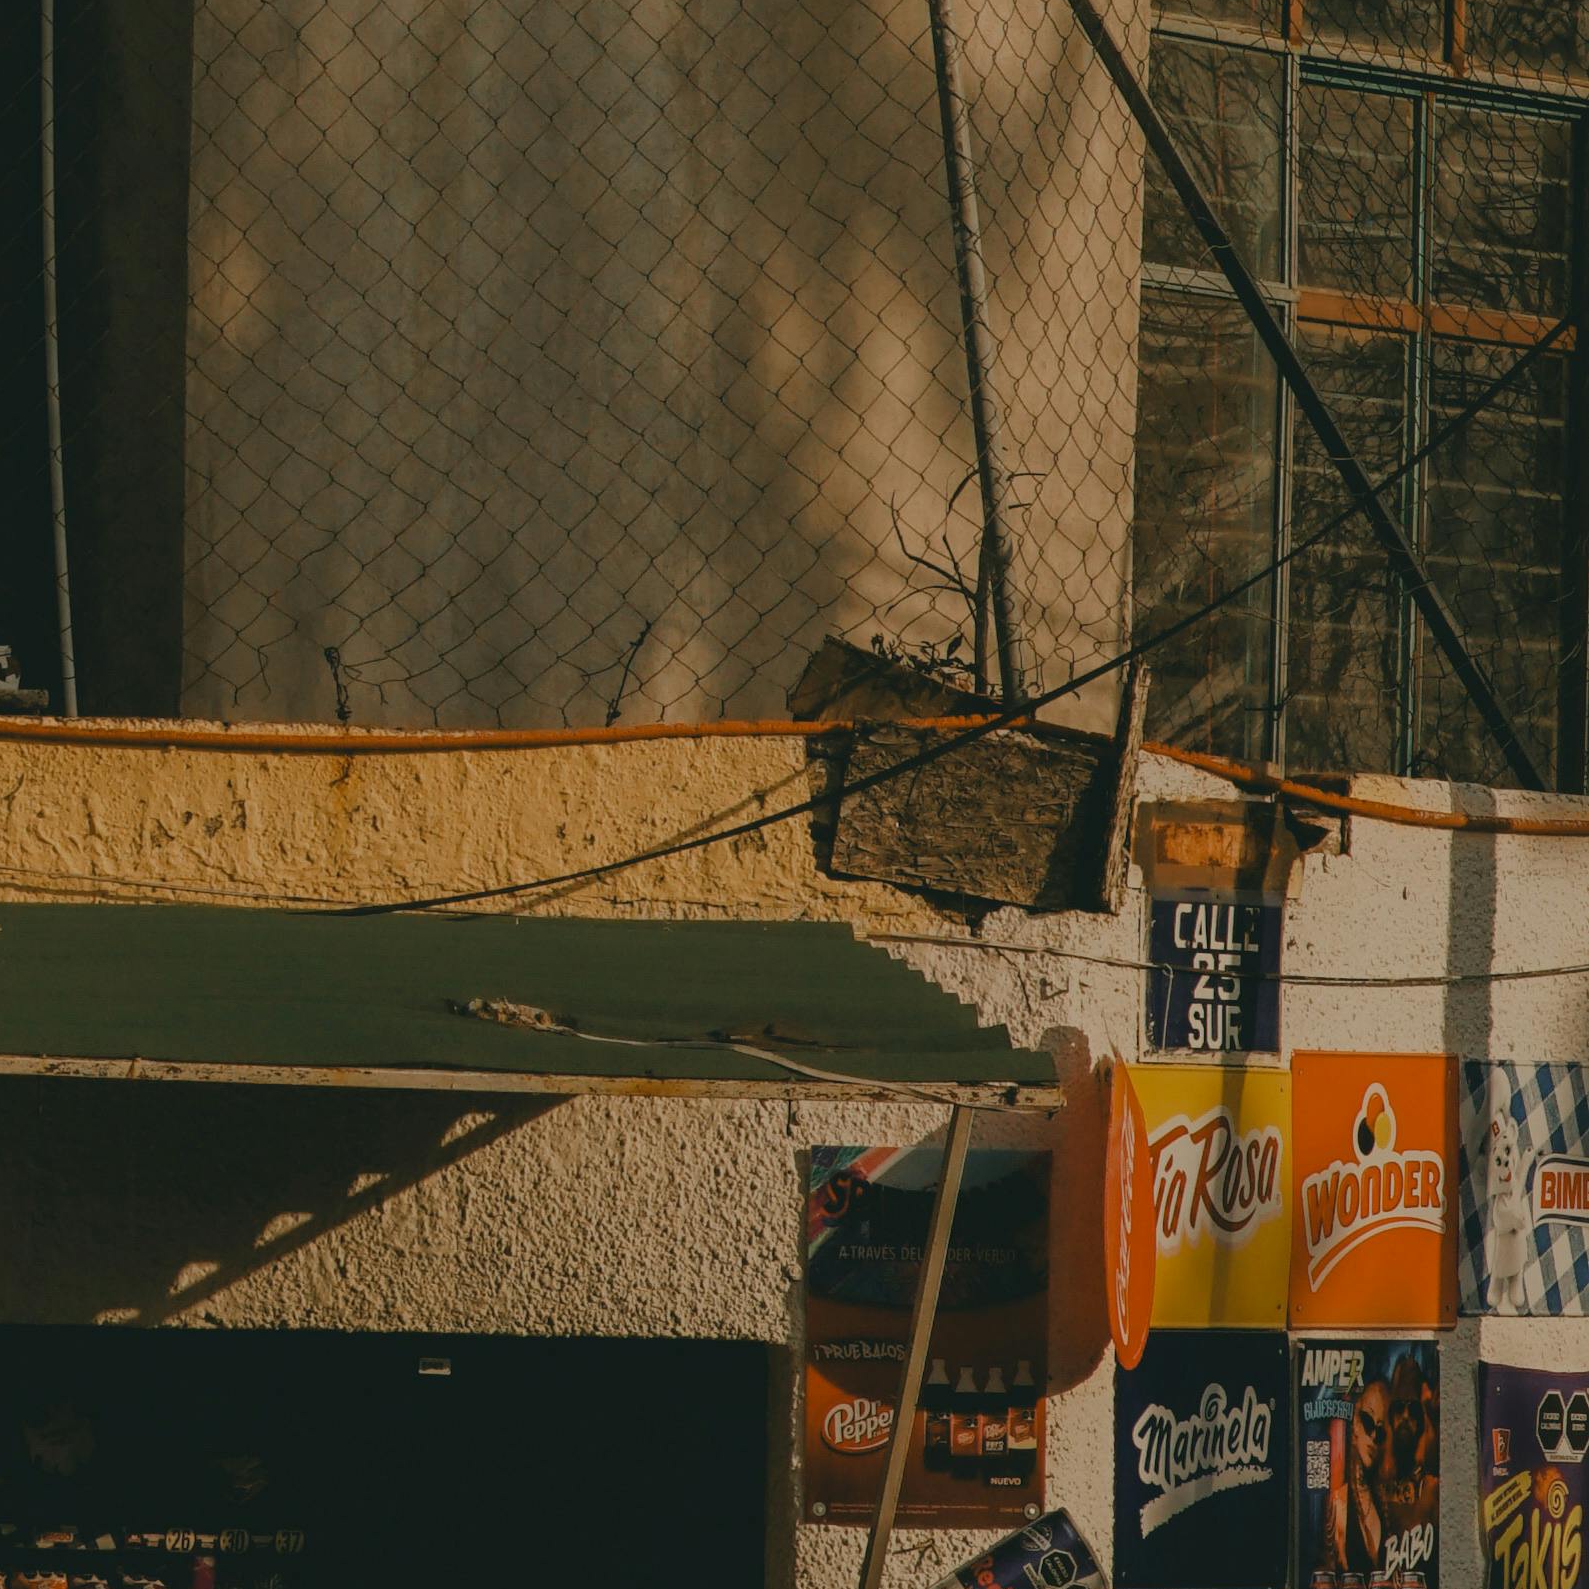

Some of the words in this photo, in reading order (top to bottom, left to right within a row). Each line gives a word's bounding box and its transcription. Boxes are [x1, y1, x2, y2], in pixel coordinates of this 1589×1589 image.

[1174, 903, 1260, 952] CALLE
[1192, 953, 1242, 1001] 25
[1187, 1003, 1242, 1051] SUR
[1190, 1115, 1279, 1233] Rosa
[1306, 1159, 1442, 1247] WONDER
[1302, 1349, 1365, 1391] AMPER
[854, 1397, 882, 1422] Dr
[1134, 1386, 1271, 1487] Marinela
[989, 1476, 1022, 1487] NUEVO
[1383, 1522, 1434, 1581] BABO
